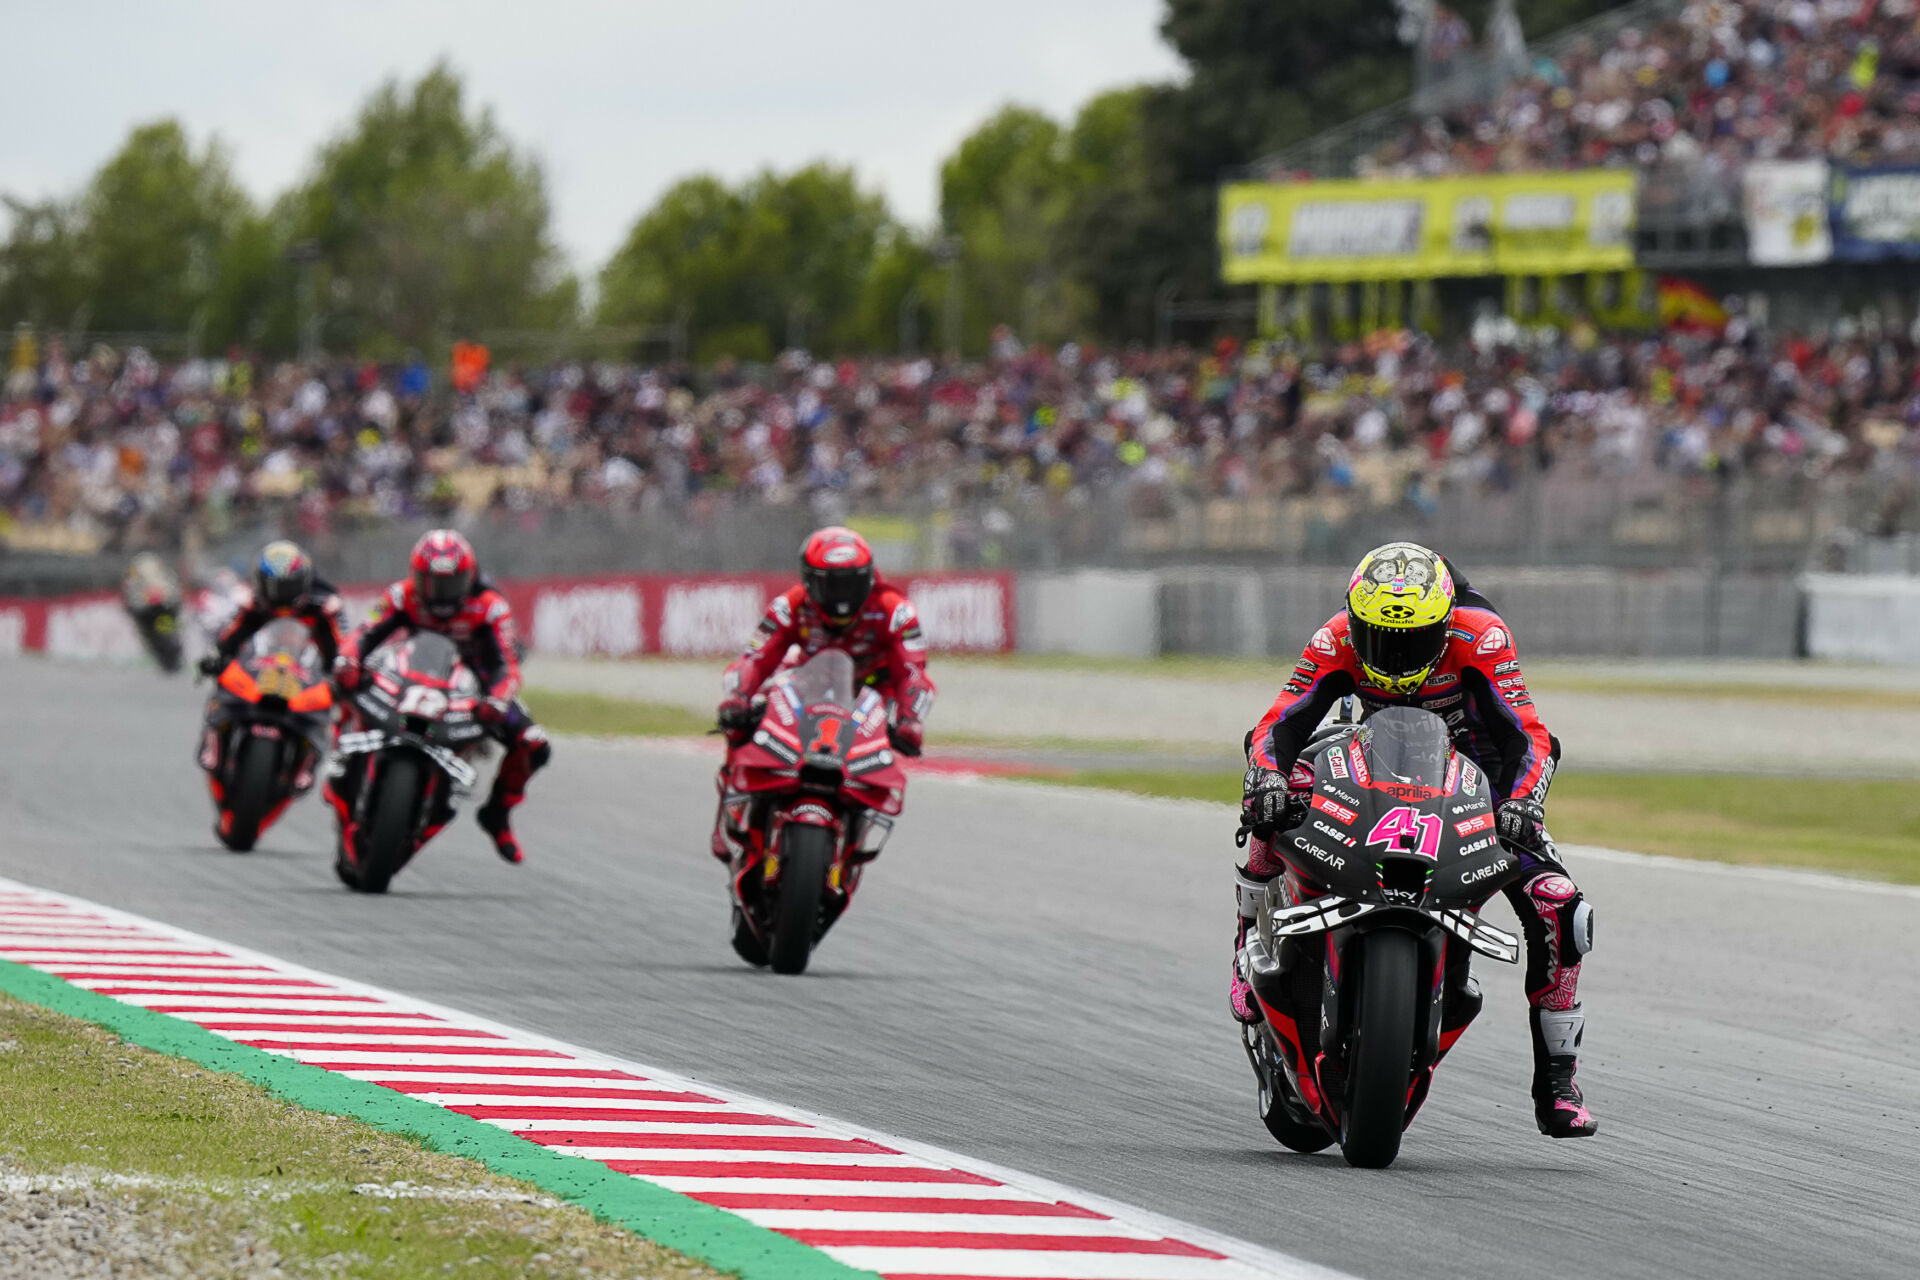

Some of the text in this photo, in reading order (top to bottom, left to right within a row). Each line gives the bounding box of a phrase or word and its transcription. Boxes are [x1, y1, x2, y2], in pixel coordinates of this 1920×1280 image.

[1532, 755, 1555, 802] aprilia
[1334, 789, 1360, 807] Marsh
[1386, 785, 1433, 801] aprilia
[1320, 800, 1356, 820] BS
[1464, 801, 1487, 811] Marsh
[1313, 821, 1346, 841] CASE
[1365, 807, 1443, 861] 41
[1456, 817, 1485, 832] BS
[1294, 837, 1346, 870] CAREAR
[1460, 838, 1488, 855] CASE
[1461, 860, 1508, 884] CAREAR
[1384, 889, 1417, 900] sky
